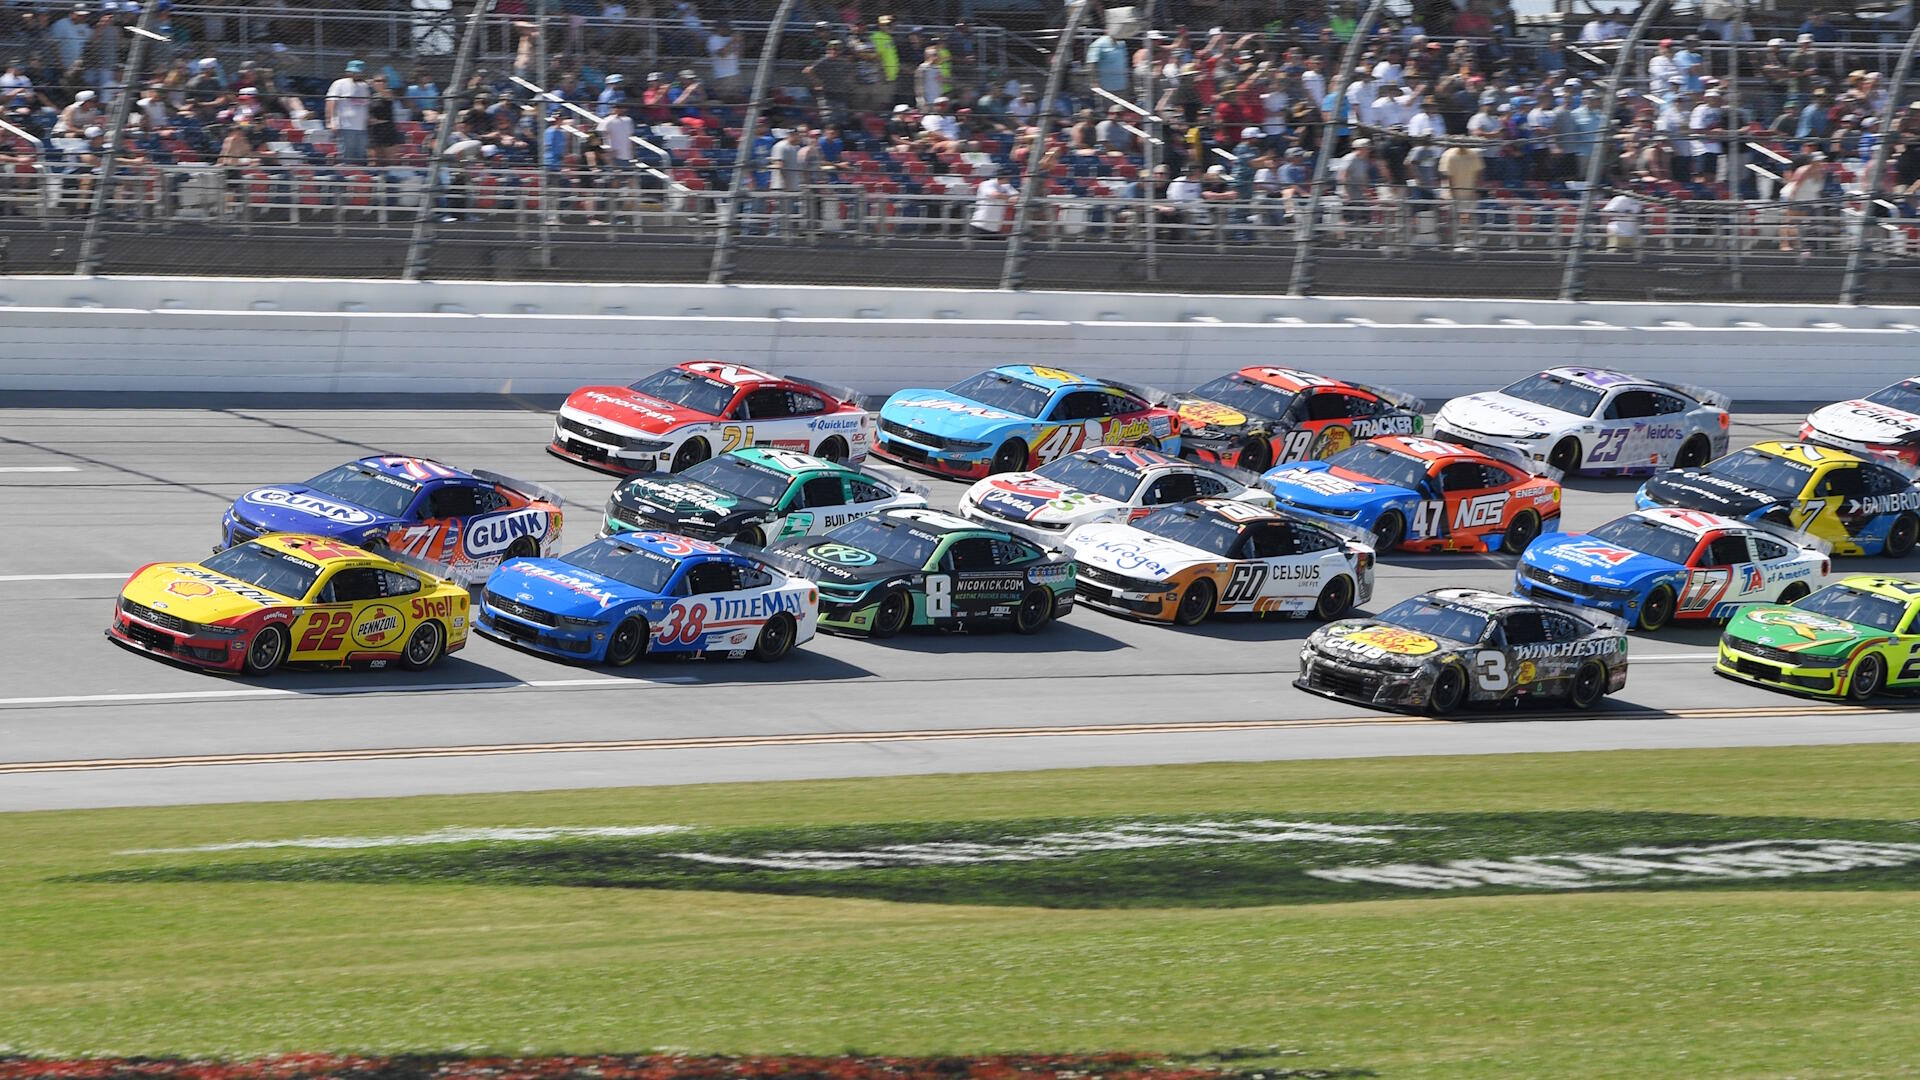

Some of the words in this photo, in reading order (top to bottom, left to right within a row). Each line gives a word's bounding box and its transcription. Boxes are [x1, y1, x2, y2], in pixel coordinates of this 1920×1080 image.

[1021, 383, 1049, 394] CUSTER
[817, 420, 841, 430] Quick
[842, 420, 858, 428] Lane
[1352, 416, 1413, 437] TRACKER
[1482, 402, 1551, 427] leidos
[1037, 425, 1083, 466] 41
[1104, 418, 1150, 446] Andy's
[1587, 428, 1631, 463] 23
[1646, 424, 1684, 440] leidos
[1275, 431, 1313, 467] 19
[1103, 463, 1142, 480] HOCEVAR
[1516, 486, 1547, 498] ENERGY
[1683, 472, 1777, 504] GAINBRIDGE
[261, 491, 358, 519] GUNK
[1454, 491, 1511, 530] NOS
[1800, 500, 1826, 535] 7
[473, 512, 542, 548] GUNK
[1412, 501, 1444, 538] 47
[402, 525, 441, 561] 71
[908, 529, 940, 544] BUSCH
[282, 555, 315, 569] LOGANO
[644, 551, 671, 564] SMITH
[773, 549, 853, 579] NICOKICK.COM
[1095, 542, 1170, 577] Kroger
[957, 579, 1025, 591] NICOKICK.COM
[1221, 563, 1270, 603] 60
[1272, 564, 1320, 580] CELSIUS
[1739, 564, 1766, 597] TA
[1767, 575, 1776, 584] of
[1777, 568, 1811, 582] America
[926, 574, 951, 618] 8
[1678, 569, 1730, 611] 17
[411, 596, 453, 620] Shell
[1455, 605, 1490, 621] DILLON
[297, 611, 353, 651] 22
[357, 616, 398, 637] PENNZOIL
[657, 603, 708, 645] 38
[1324, 637, 1387, 659] CLUB
[1513, 637, 1618, 661] WINCHESTER
[1476, 650, 1510, 691] 3
